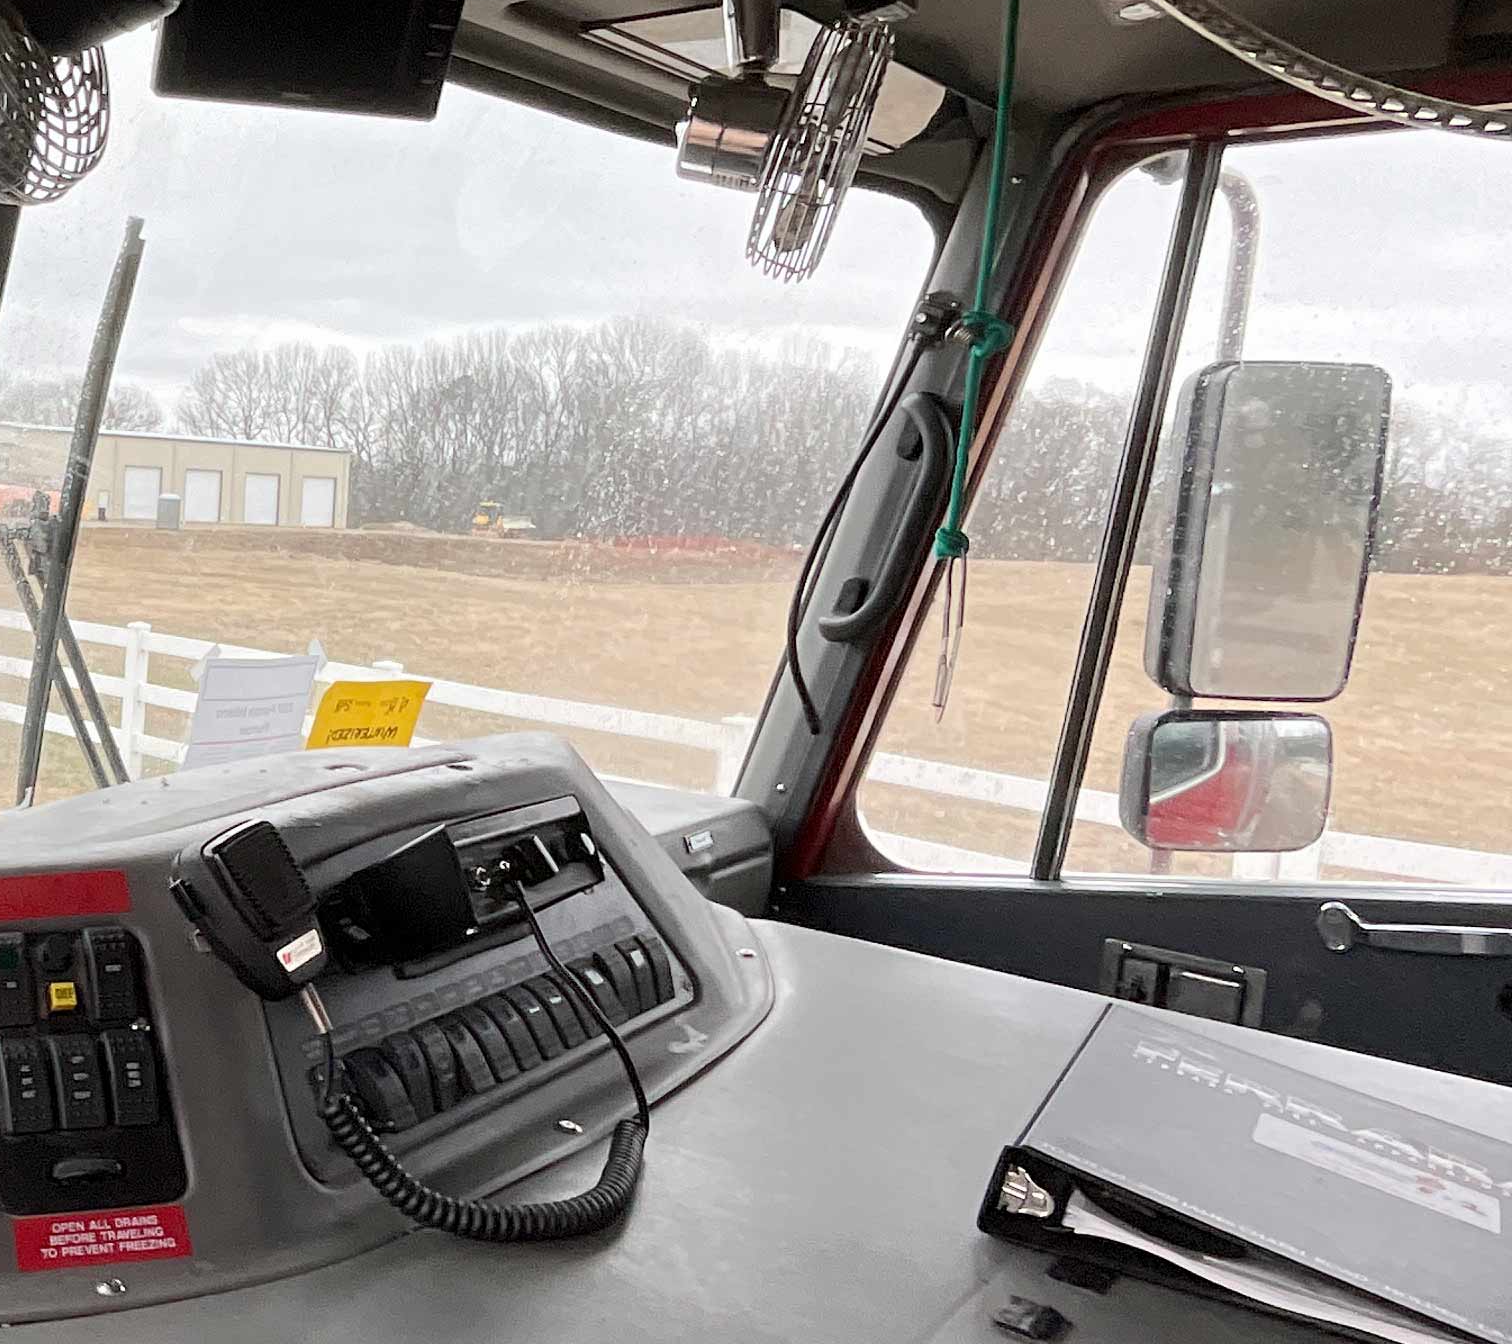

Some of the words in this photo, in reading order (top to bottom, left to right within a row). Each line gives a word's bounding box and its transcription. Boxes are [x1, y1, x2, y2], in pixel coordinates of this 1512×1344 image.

[52, 1221, 86, 1234] OPEN
[89, 1218, 111, 1231] ALL
[115, 1214, 159, 1228] DRAINS
[49, 1232, 97, 1247] BEFORE
[100, 1226, 165, 1242] TRAVELING
[40, 1248, 58, 1260] TO
[61, 1242, 116, 1257] PREVENT
[119, 1237, 177, 1253] FREEZING
